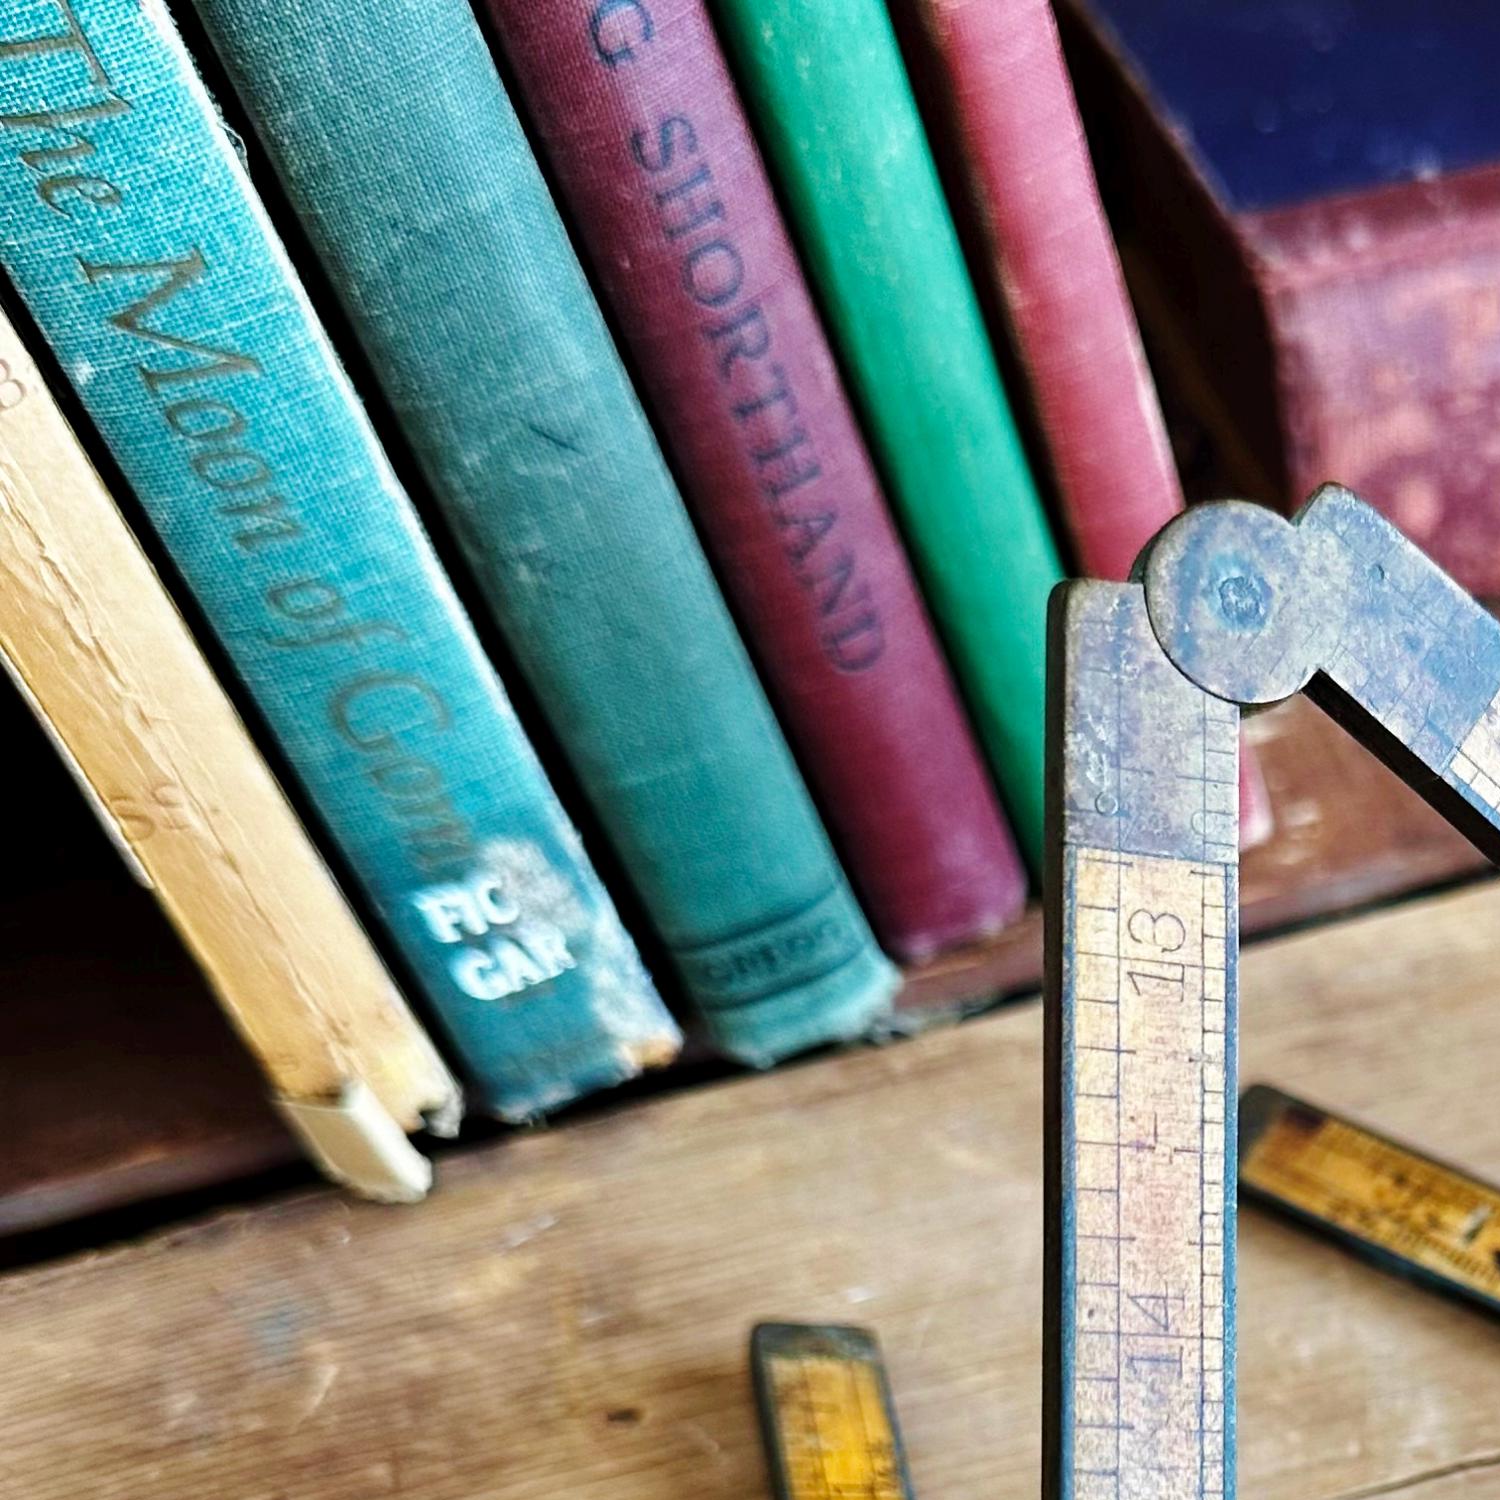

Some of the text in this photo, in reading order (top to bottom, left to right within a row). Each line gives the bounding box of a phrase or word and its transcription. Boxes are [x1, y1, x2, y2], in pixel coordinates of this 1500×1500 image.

[0, 0, 134, 218] The
[75, 246, 303, 553] Moon
[266, 577, 408, 651] of
[631, 115, 886, 675] SHORTHAND
[414, 873, 520, 943] FIC
[1126, 908, 1188, 1004] 13
[1127, 1280, 1186, 1381] 14
